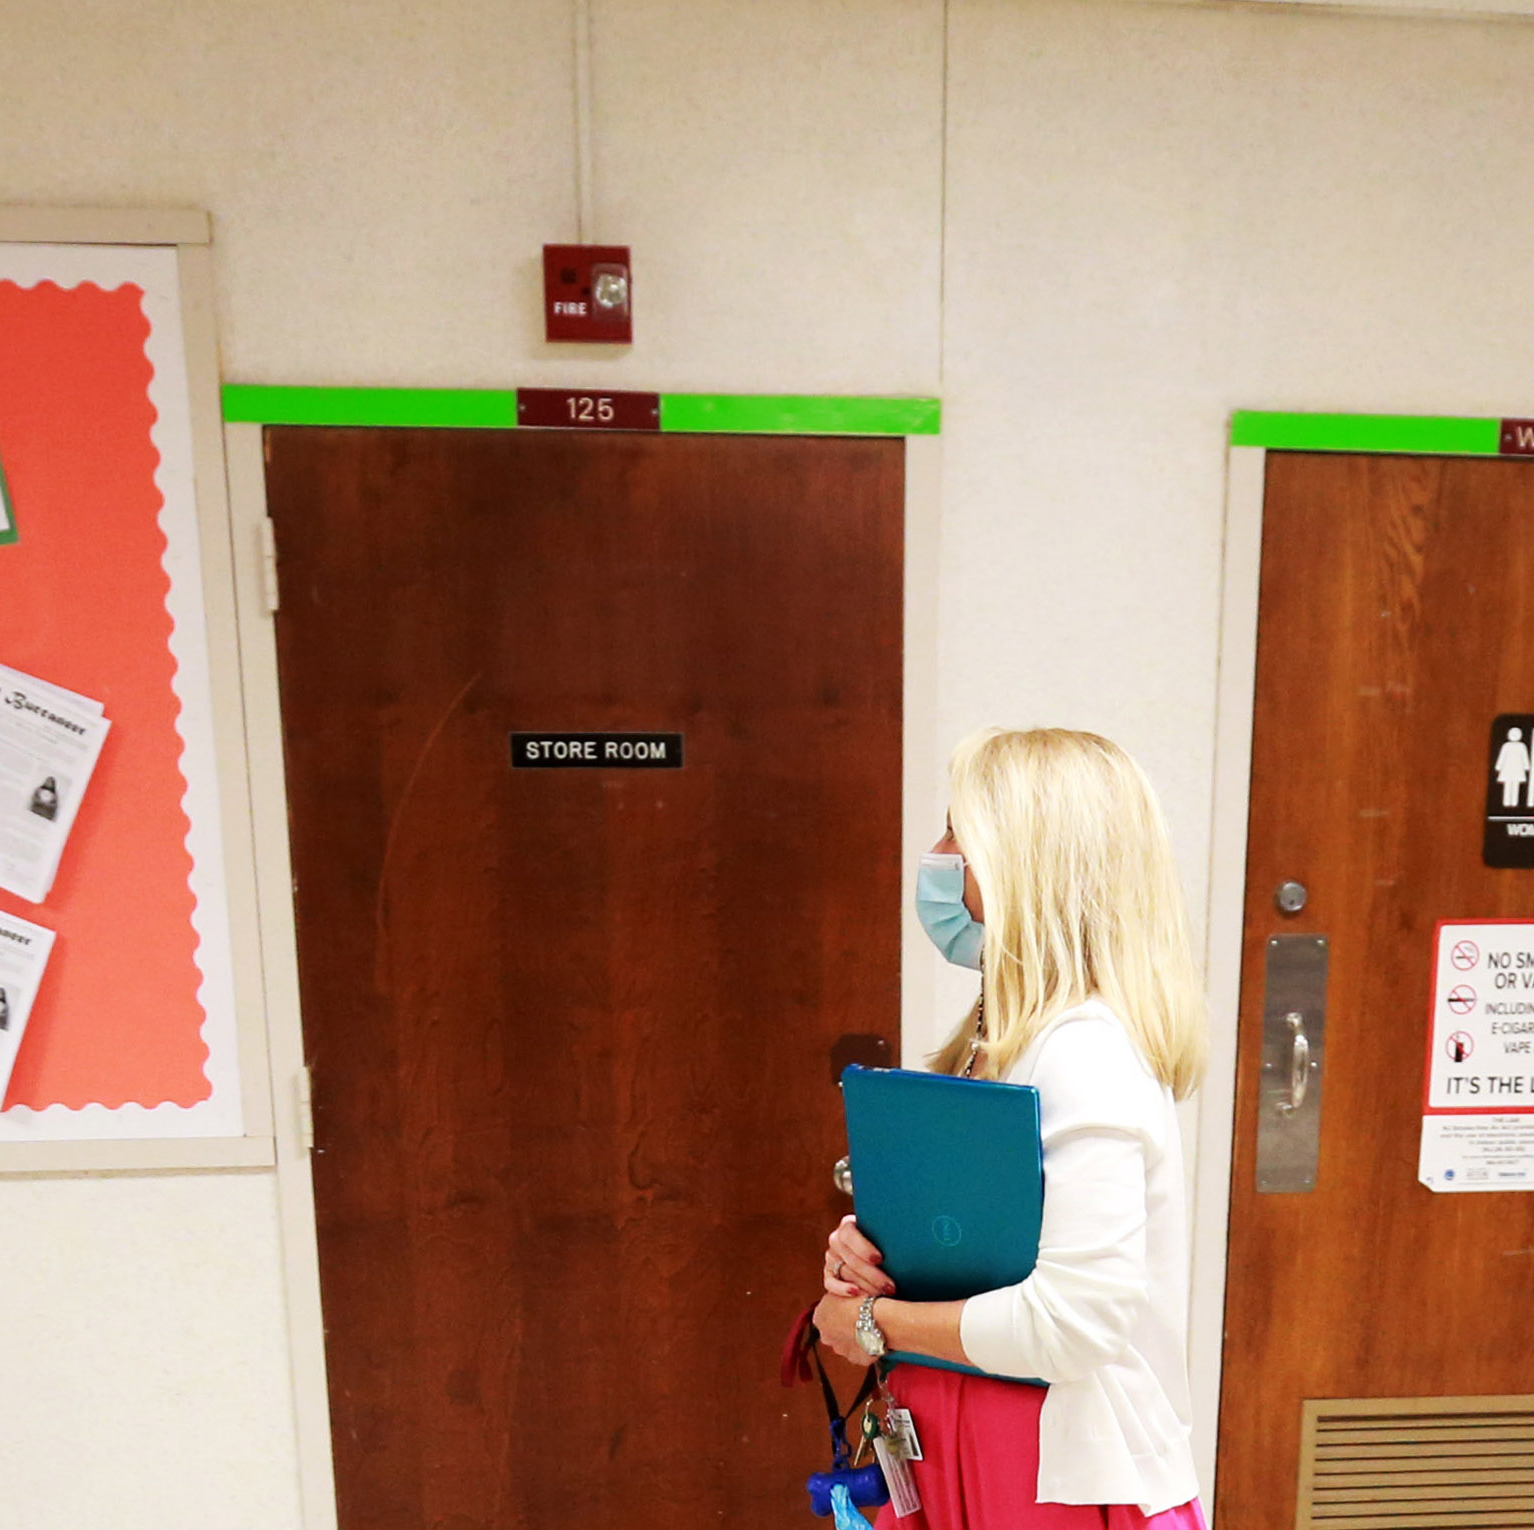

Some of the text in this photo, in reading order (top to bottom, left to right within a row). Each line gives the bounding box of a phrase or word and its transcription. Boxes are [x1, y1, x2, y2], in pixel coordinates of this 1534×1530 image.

[554, 302, 587, 315] FIRE
[567, 397, 614, 420] 125
[526, 741, 666, 760] STORE ROOM
[1487, 952, 1511, 969] NO
[1495, 972, 1517, 989] OR
[1503, 1041, 1531, 1054] VAPE
[1446, 1076, 1481, 1095] IT'S
[1487, 1076, 1524, 1094] THE
